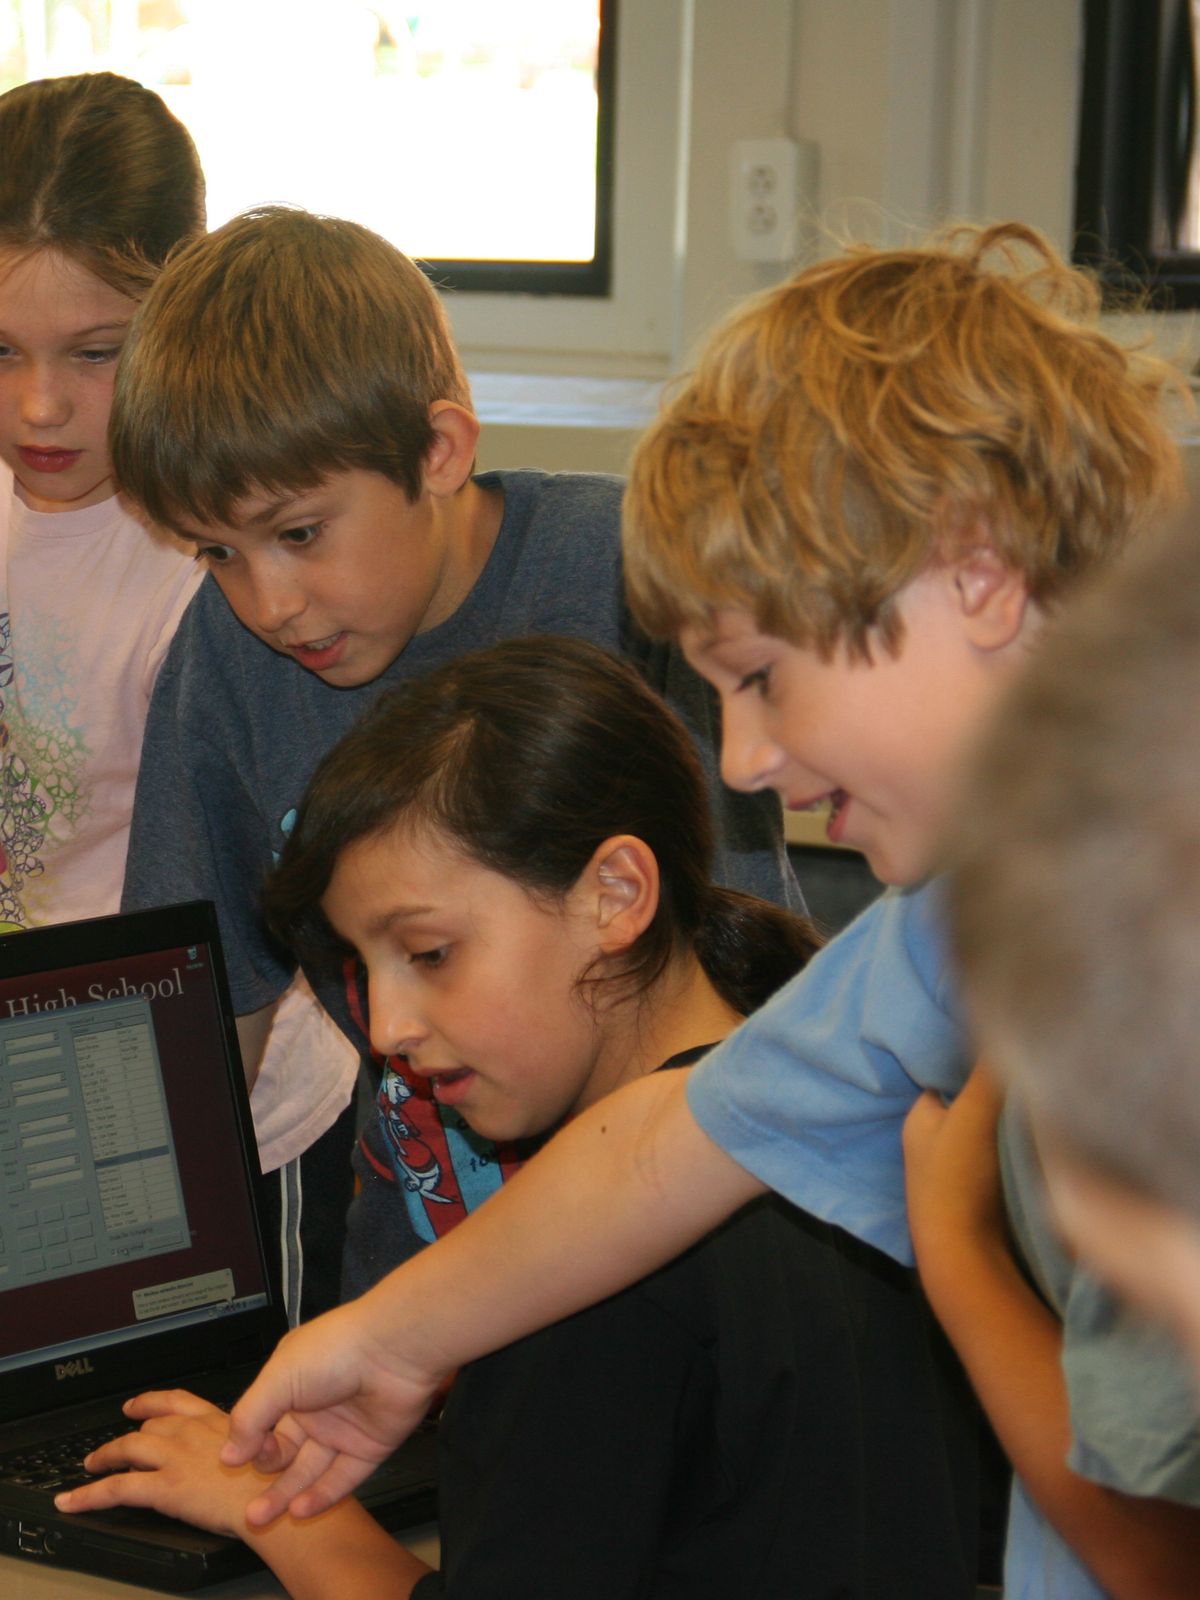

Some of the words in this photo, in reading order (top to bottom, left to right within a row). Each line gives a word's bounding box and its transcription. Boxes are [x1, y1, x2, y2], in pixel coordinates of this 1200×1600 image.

[5, 987, 78, 1018] High
[87, 967, 185, 1002] School
[54, 1357, 95, 1381] DELL
